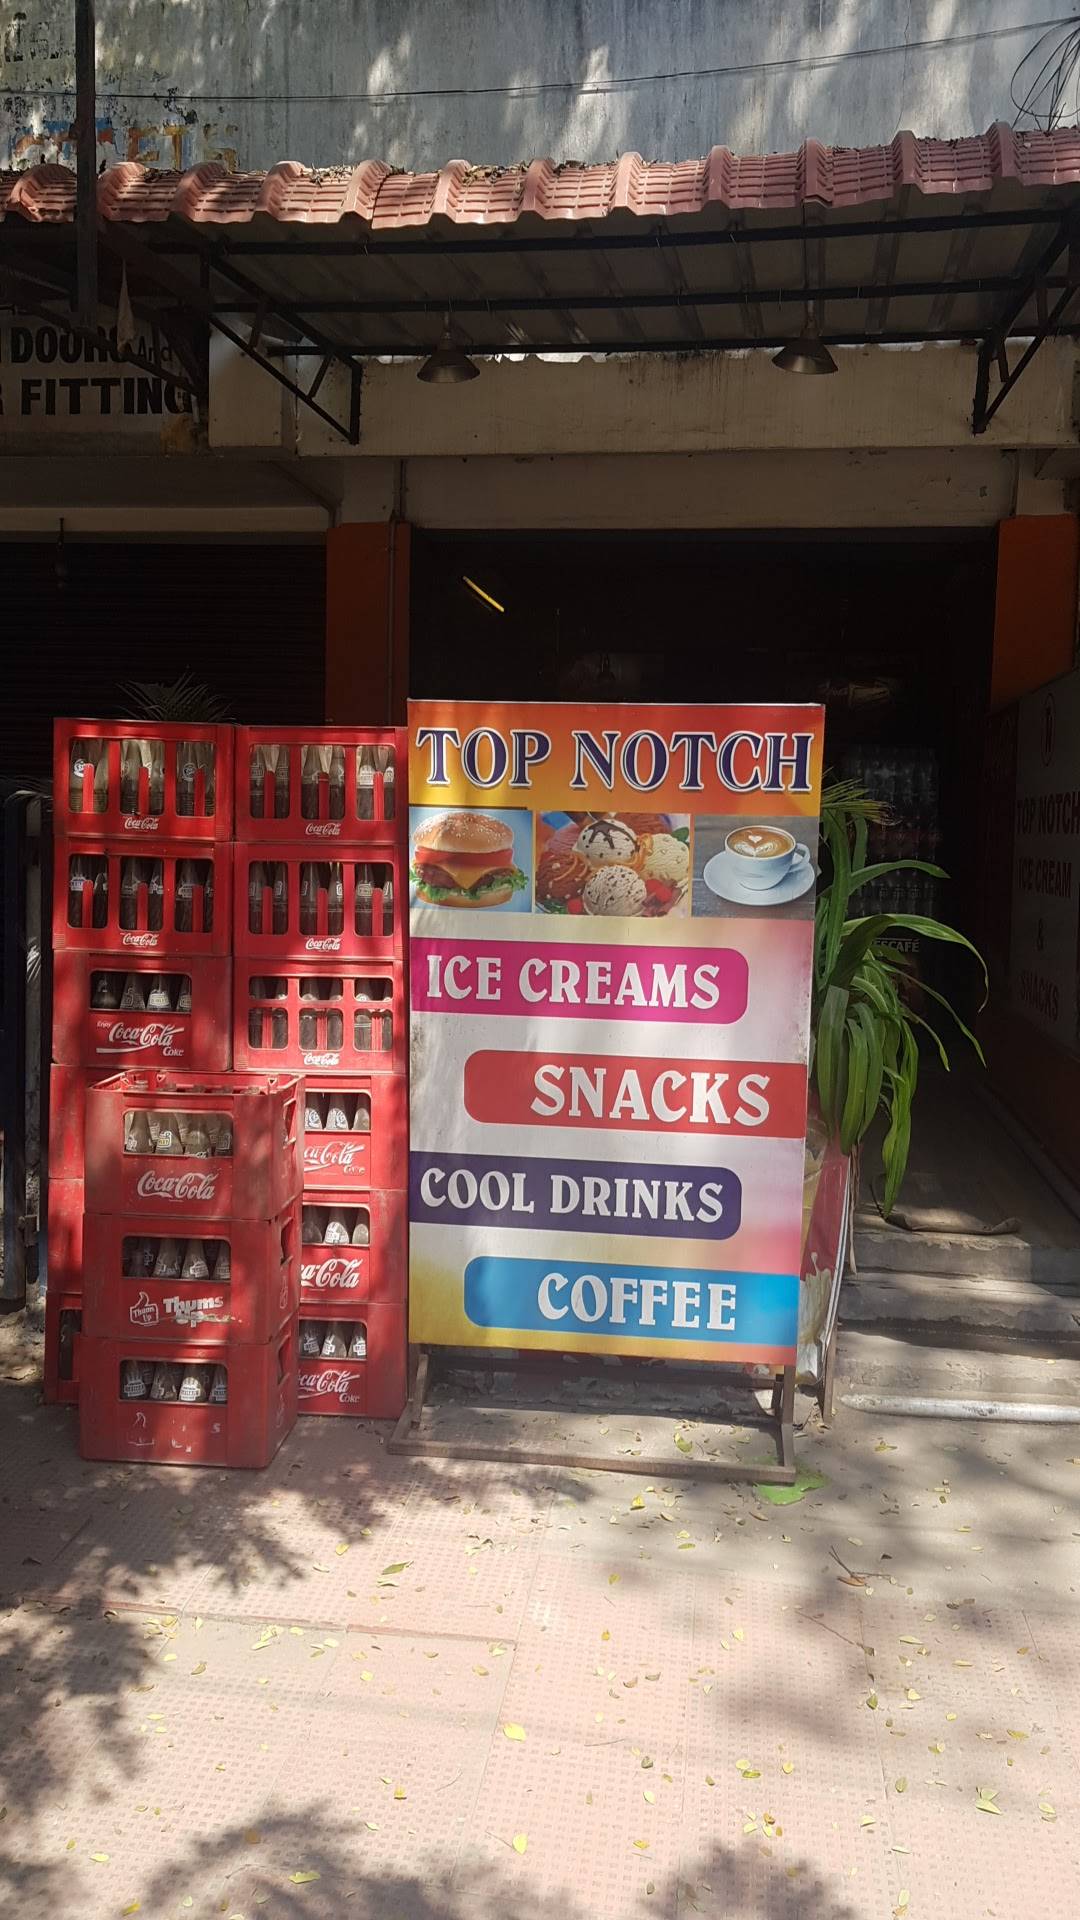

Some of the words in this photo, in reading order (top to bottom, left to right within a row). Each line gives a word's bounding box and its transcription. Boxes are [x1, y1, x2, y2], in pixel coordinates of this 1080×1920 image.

[416, 727, 551, 788] TOP
[571, 729, 814, 791] NOTCH
[124, 816, 159, 830] Coca-Cola
[305, 823, 341, 835] Coca-Cola
[122, 933, 159, 946] Coca-Cola
[305, 937, 341, 950] Coca-Cola
[427, 955, 501, 999] ICE
[518, 958, 720, 1010] CREAMS
[108, 1022, 184, 1046] Coca-Cola
[530, 1064, 771, 1127] SNACKS
[137, 1169, 220, 1200] Coca-Cola
[420, 1167, 534, 1213] COOL
[550, 1174, 723, 1223] DRINKS
[537, 1272, 736, 1331] COFFEE
